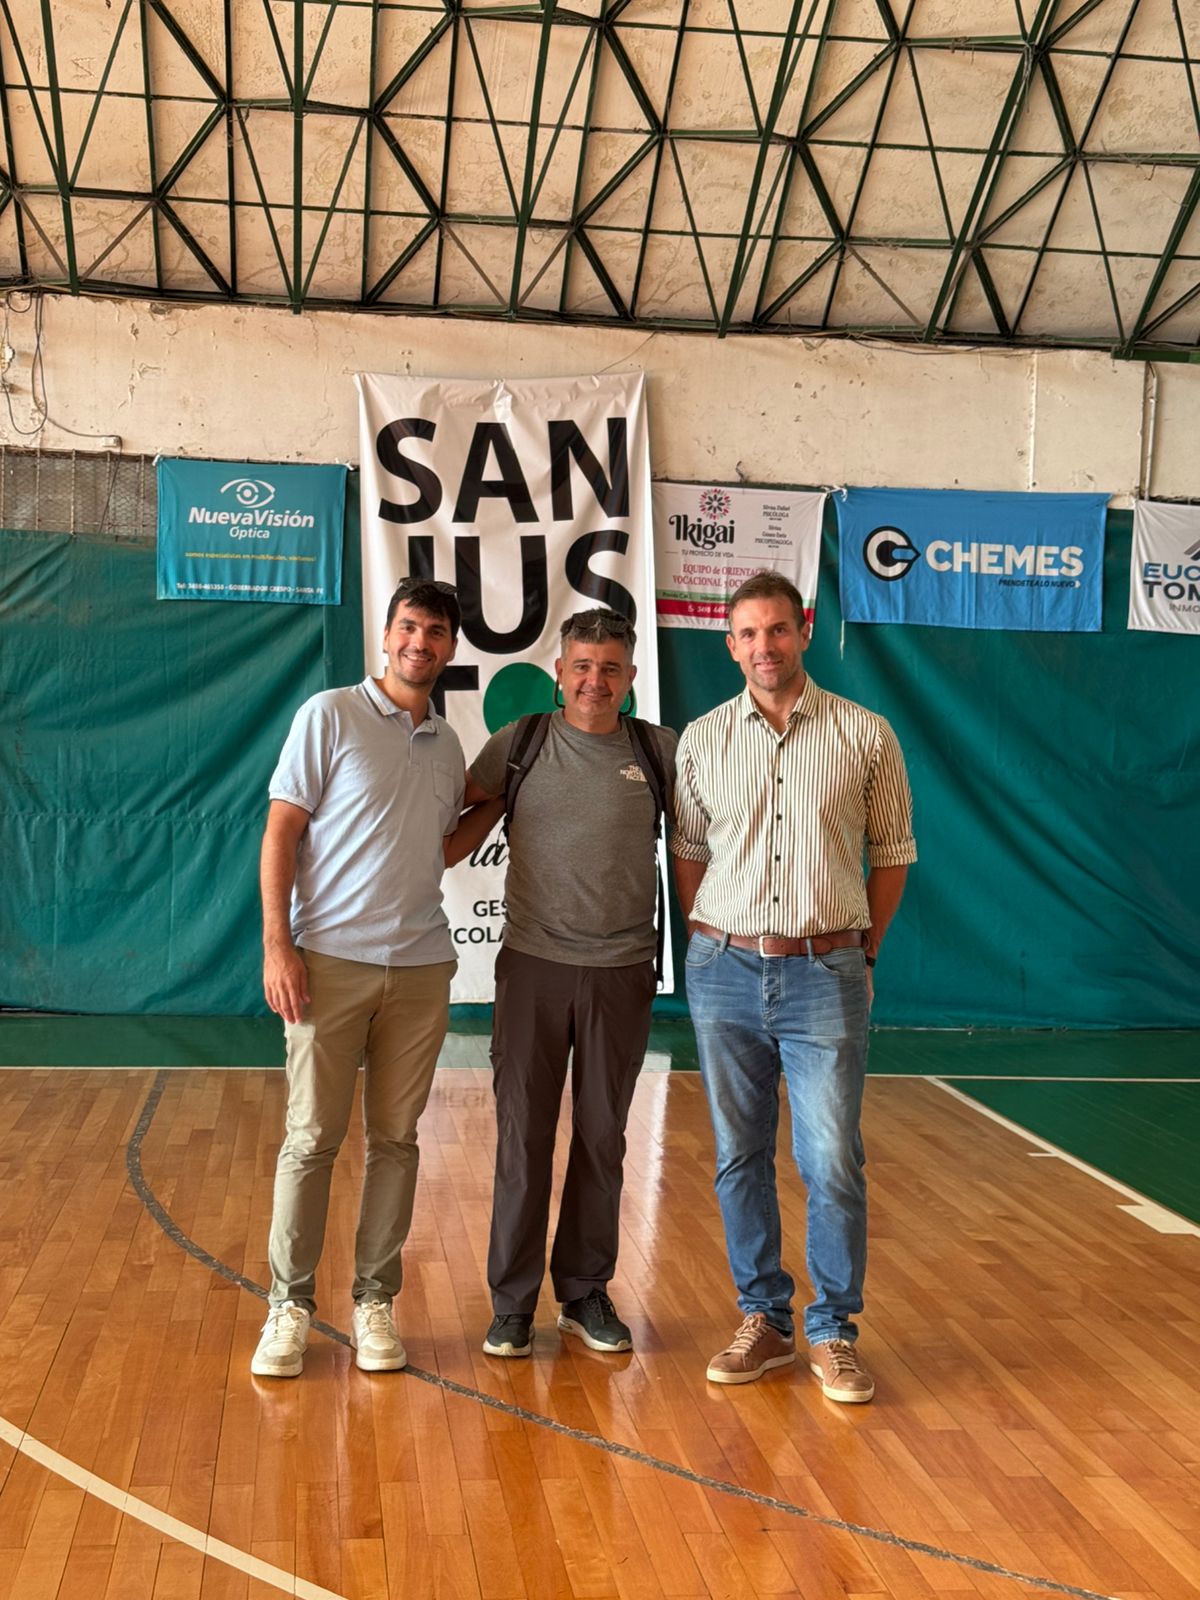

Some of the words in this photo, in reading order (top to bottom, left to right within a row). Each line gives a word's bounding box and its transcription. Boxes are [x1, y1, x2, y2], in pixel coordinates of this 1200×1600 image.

[376, 417, 630, 525] SAN
[188, 507, 315, 528] NuevaVisión
[229, 526, 271, 541] Óptica
[669, 514, 735, 550] Ikigai
[689, 550, 714, 558] PROYECTO
[925, 540, 1084, 577] CHEMES
[682, 563, 712, 574] EQUIPO
[712, 566, 721, 575] de
[672, 575, 722, 587] VOCACIONAL
